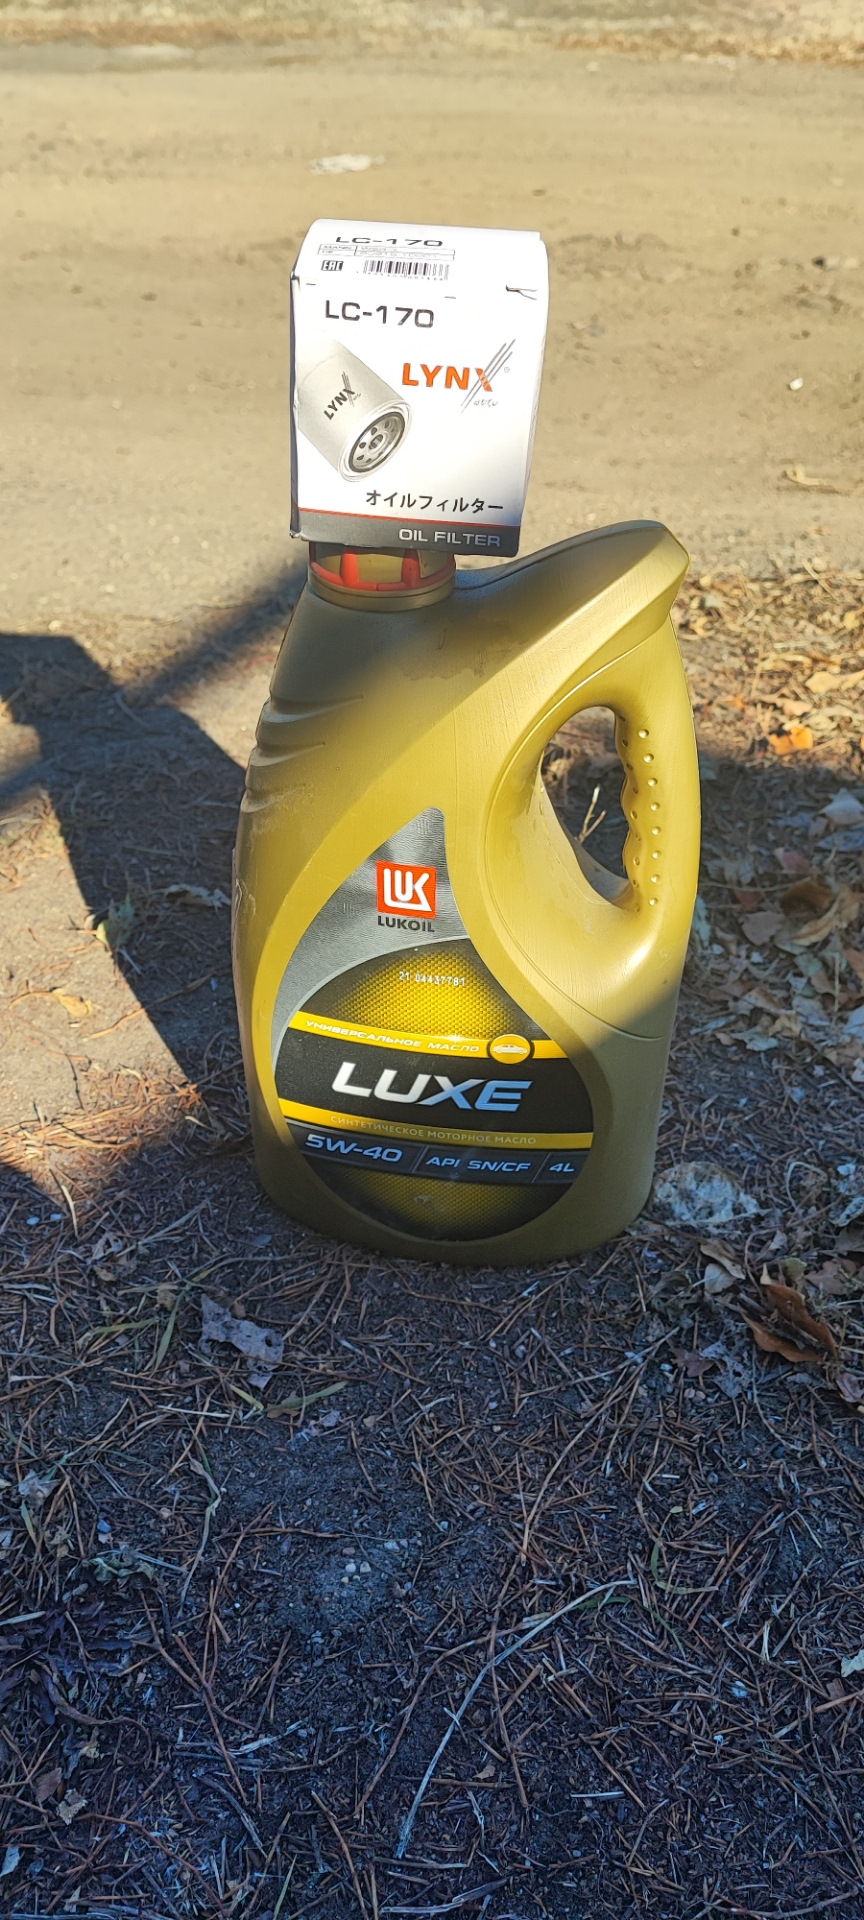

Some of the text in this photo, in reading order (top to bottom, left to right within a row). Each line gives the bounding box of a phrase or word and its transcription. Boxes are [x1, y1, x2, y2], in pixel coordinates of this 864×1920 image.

[335, 236, 443, 247] LC-170
[325, 300, 434, 328] LC-170
[402, 361, 494, 393] LYNX
[323, 388, 356, 420] LYNX
[365, 489, 504, 513] オイルフィルター
[398, 528, 501, 547] OIL FILTER
[377, 915, 436, 933] LUKOIL
[399, 971, 410, 981] 21
[304, 1019, 480, 1053] УНИВЕРСАЛЬНОЕ МАСЛО
[331, 1061, 534, 1112] LUXE
[330, 1115, 537, 1145] СИНТЕТИЧЕСКОЕ МОТОРНОЕ МАСЛО
[305, 1133, 403, 1163] 5W-40
[425, 1156, 532, 1173] API SN/CF
[549, 1162, 575, 1173] 4L
